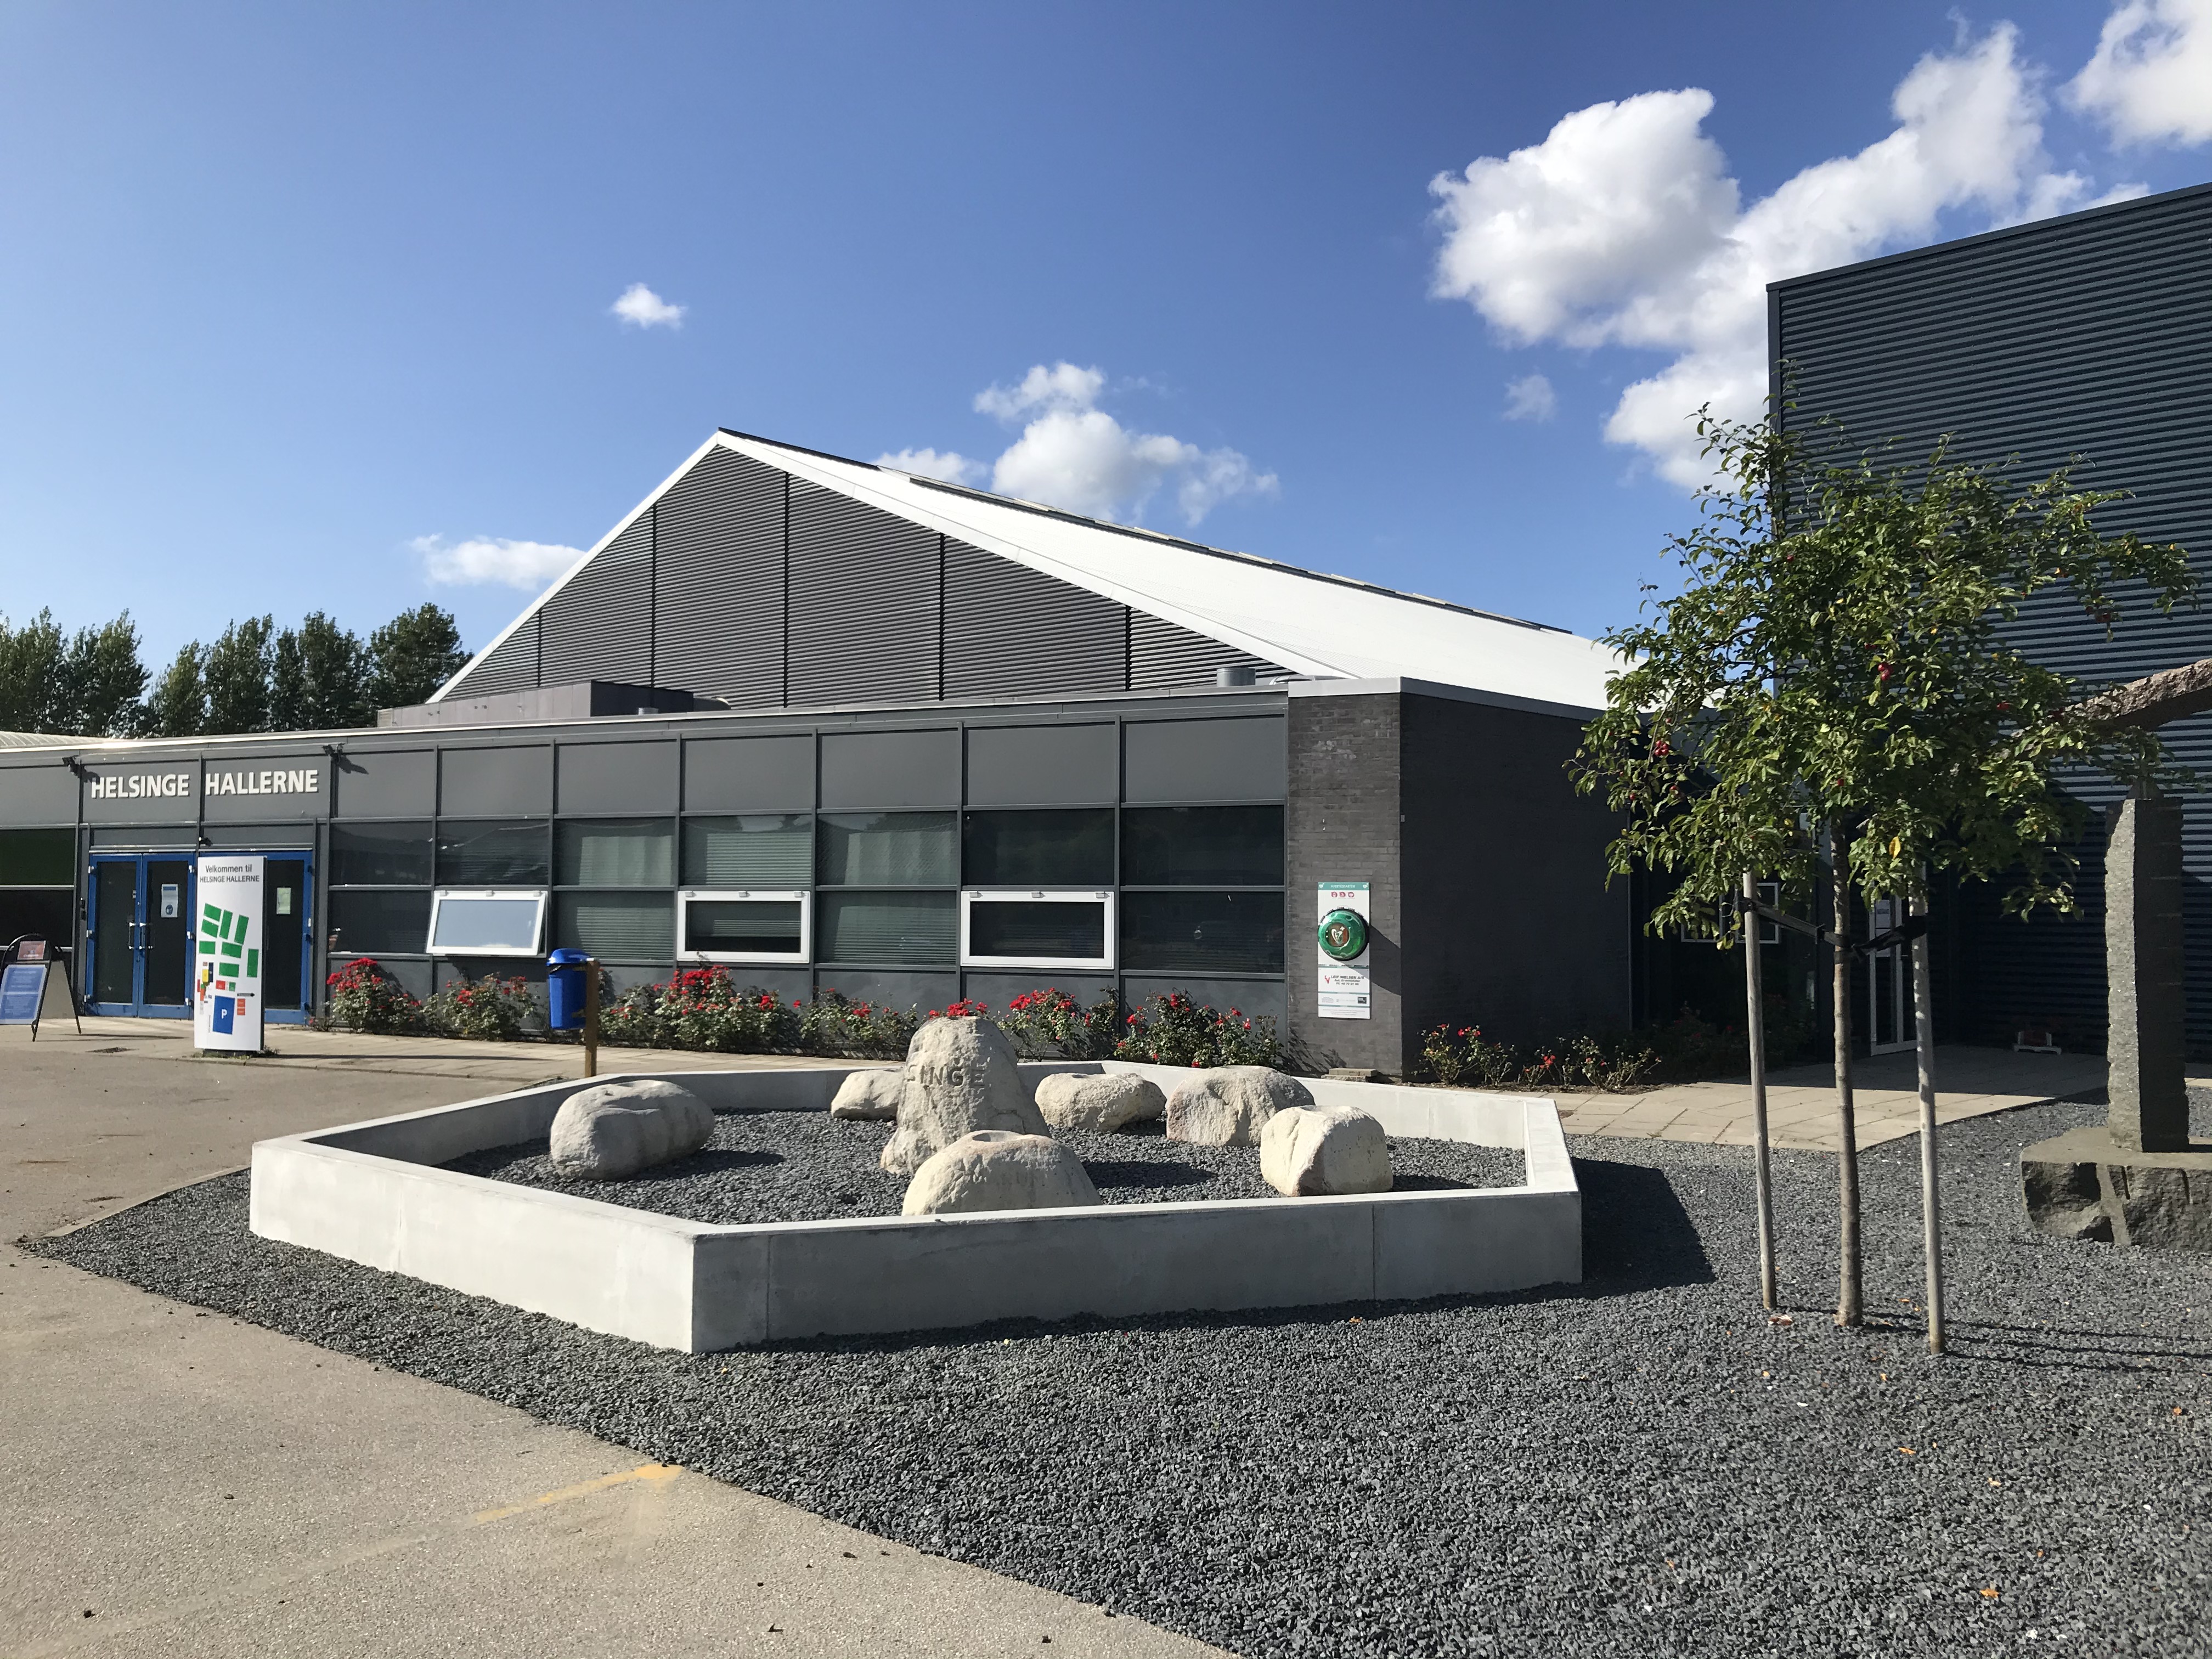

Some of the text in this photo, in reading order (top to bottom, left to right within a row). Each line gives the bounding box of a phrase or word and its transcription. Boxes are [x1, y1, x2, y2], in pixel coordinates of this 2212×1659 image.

[91, 769, 319, 799] HELSINGE HALLERNE
[205, 865, 243, 873] Velkommen
[200, 874, 260, 883] HELSINGE HALLERNE
[221, 1008, 228, 1019] P
